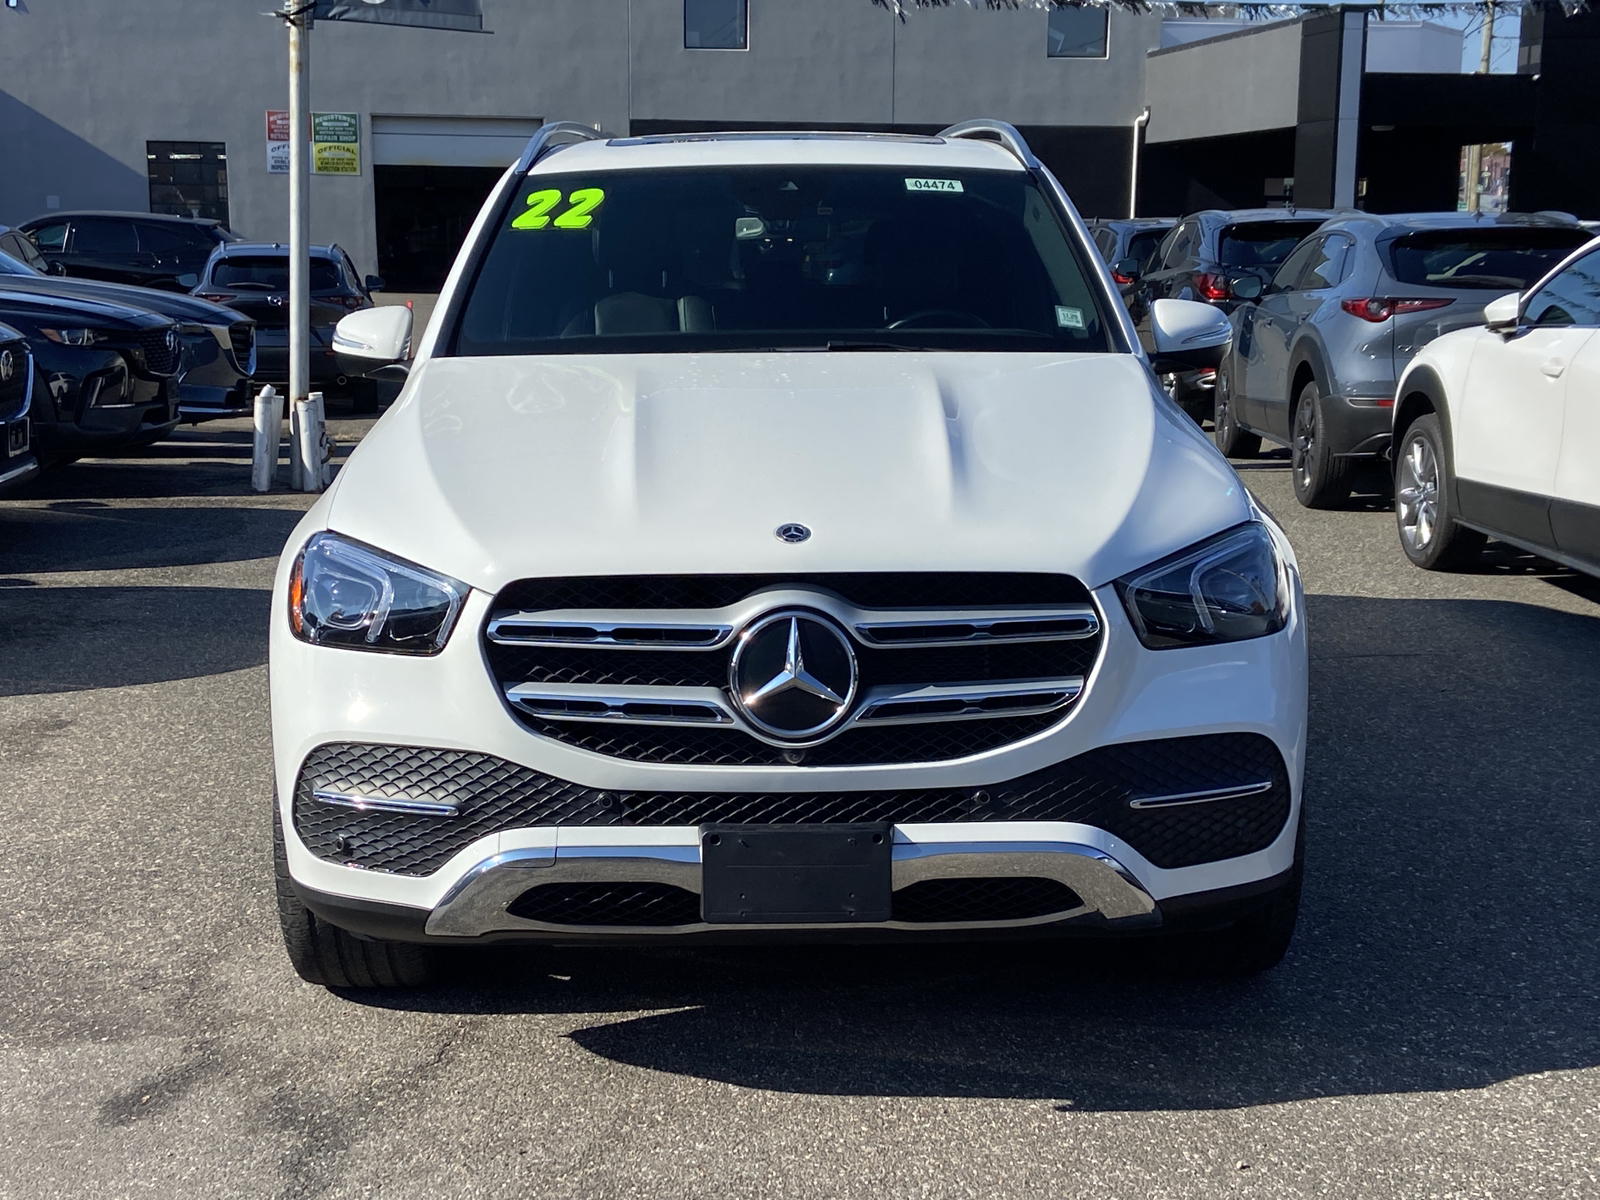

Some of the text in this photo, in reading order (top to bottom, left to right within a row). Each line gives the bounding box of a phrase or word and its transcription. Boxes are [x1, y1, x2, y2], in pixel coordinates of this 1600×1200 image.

[315, 114, 356, 124] REGISTERED
[317, 144, 357, 156] OFFICIAL
[914, 179, 955, 190] 04474
[511, 188, 605, 230] 22
